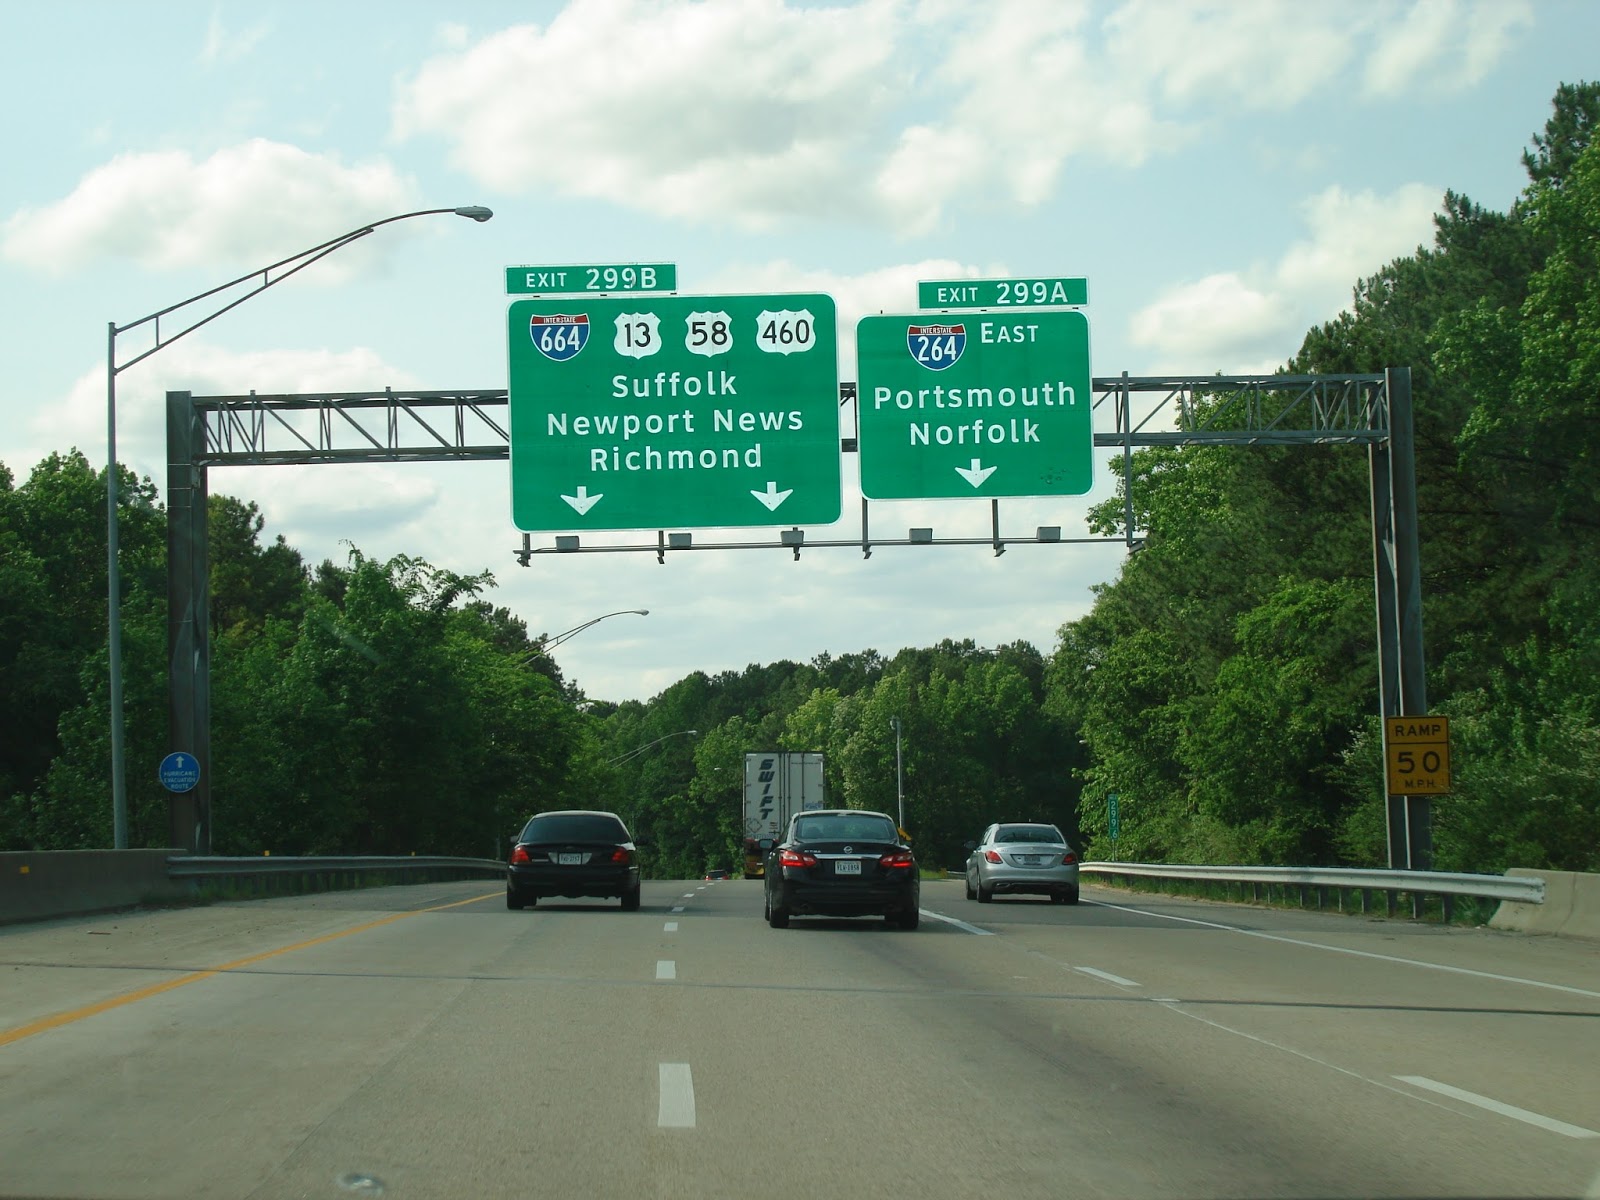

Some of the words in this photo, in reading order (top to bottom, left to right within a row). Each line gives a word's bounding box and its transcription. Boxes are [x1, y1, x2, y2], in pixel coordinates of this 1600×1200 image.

[525, 273, 567, 288] EXIT
[585, 267, 657, 290] 299B
[938, 287, 978, 303] EXIT
[996, 281, 1068, 304] 299A
[543, 316, 577, 324] INTERSTATE
[762, 319, 811, 345] 460
[980, 322, 1039, 344] EAST
[540, 326, 581, 352] 664
[623, 321, 651, 348] 13
[691, 321, 728, 346] 58
[917, 336, 957, 362] 264
[611, 371, 738, 398] Suffolk
[874, 381, 1075, 410] Portsmouth
[547, 409, 694, 440] Newport
[713, 408, 804, 433] News
[910, 418, 1041, 446] Norfolk
[590, 443, 763, 472] Richmond
[1395, 724, 1441, 737] RAMP
[1397, 751, 1441, 774] 50
[758, 758, 775, 820] SWIFT
